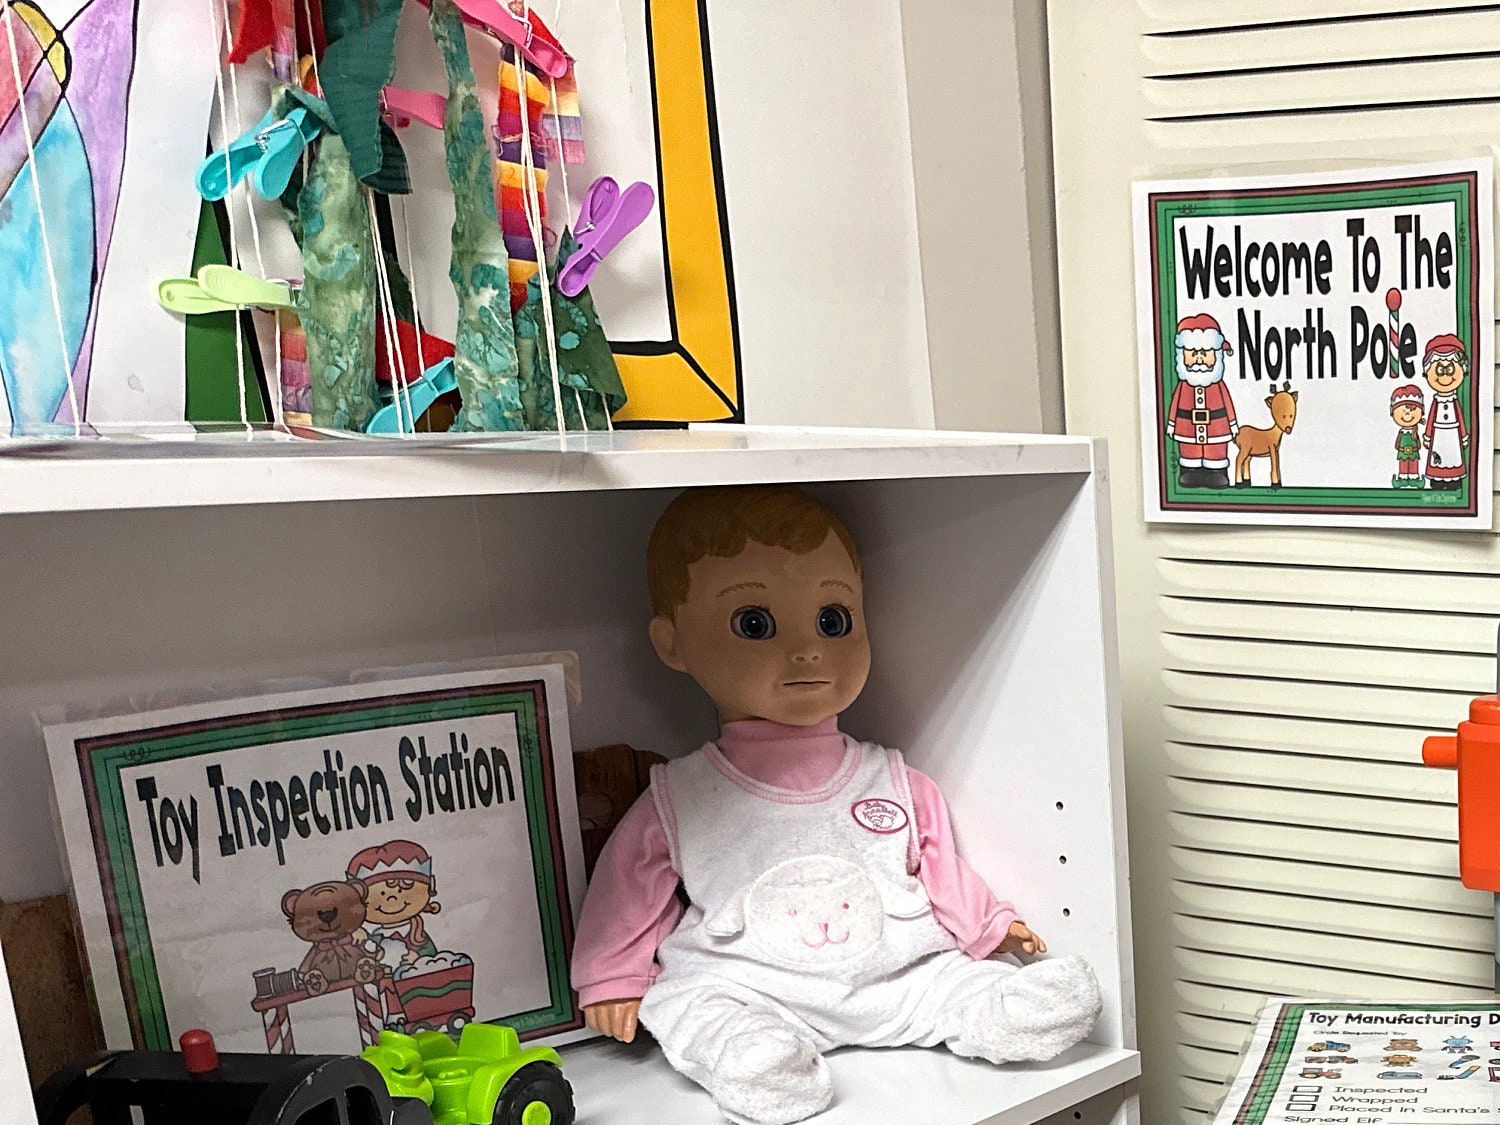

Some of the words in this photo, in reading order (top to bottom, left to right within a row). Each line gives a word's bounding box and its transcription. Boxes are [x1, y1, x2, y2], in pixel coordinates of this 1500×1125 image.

[1178, 224, 1333, 300] Welcome
[1347, 218, 1380, 294] To
[1394, 214, 1453, 291] The
[1237, 306, 1337, 382] North
[136, 775, 201, 885] Toy
[206, 749, 394, 866] Inspection
[398, 732, 516, 822] Station
[1309, 1012, 1339, 1027] Toy
[1344, 1012, 1481, 1028] Manufacturing
[1332, 1086, 1428, 1095] Inspected
[1332, 1096, 1418, 1105] Wrapped
[1329, 1105, 1392, 1113] Placed
[1423, 1106, 1490, 1114] Santa's
[1284, 1116, 1349, 1124] Signed
